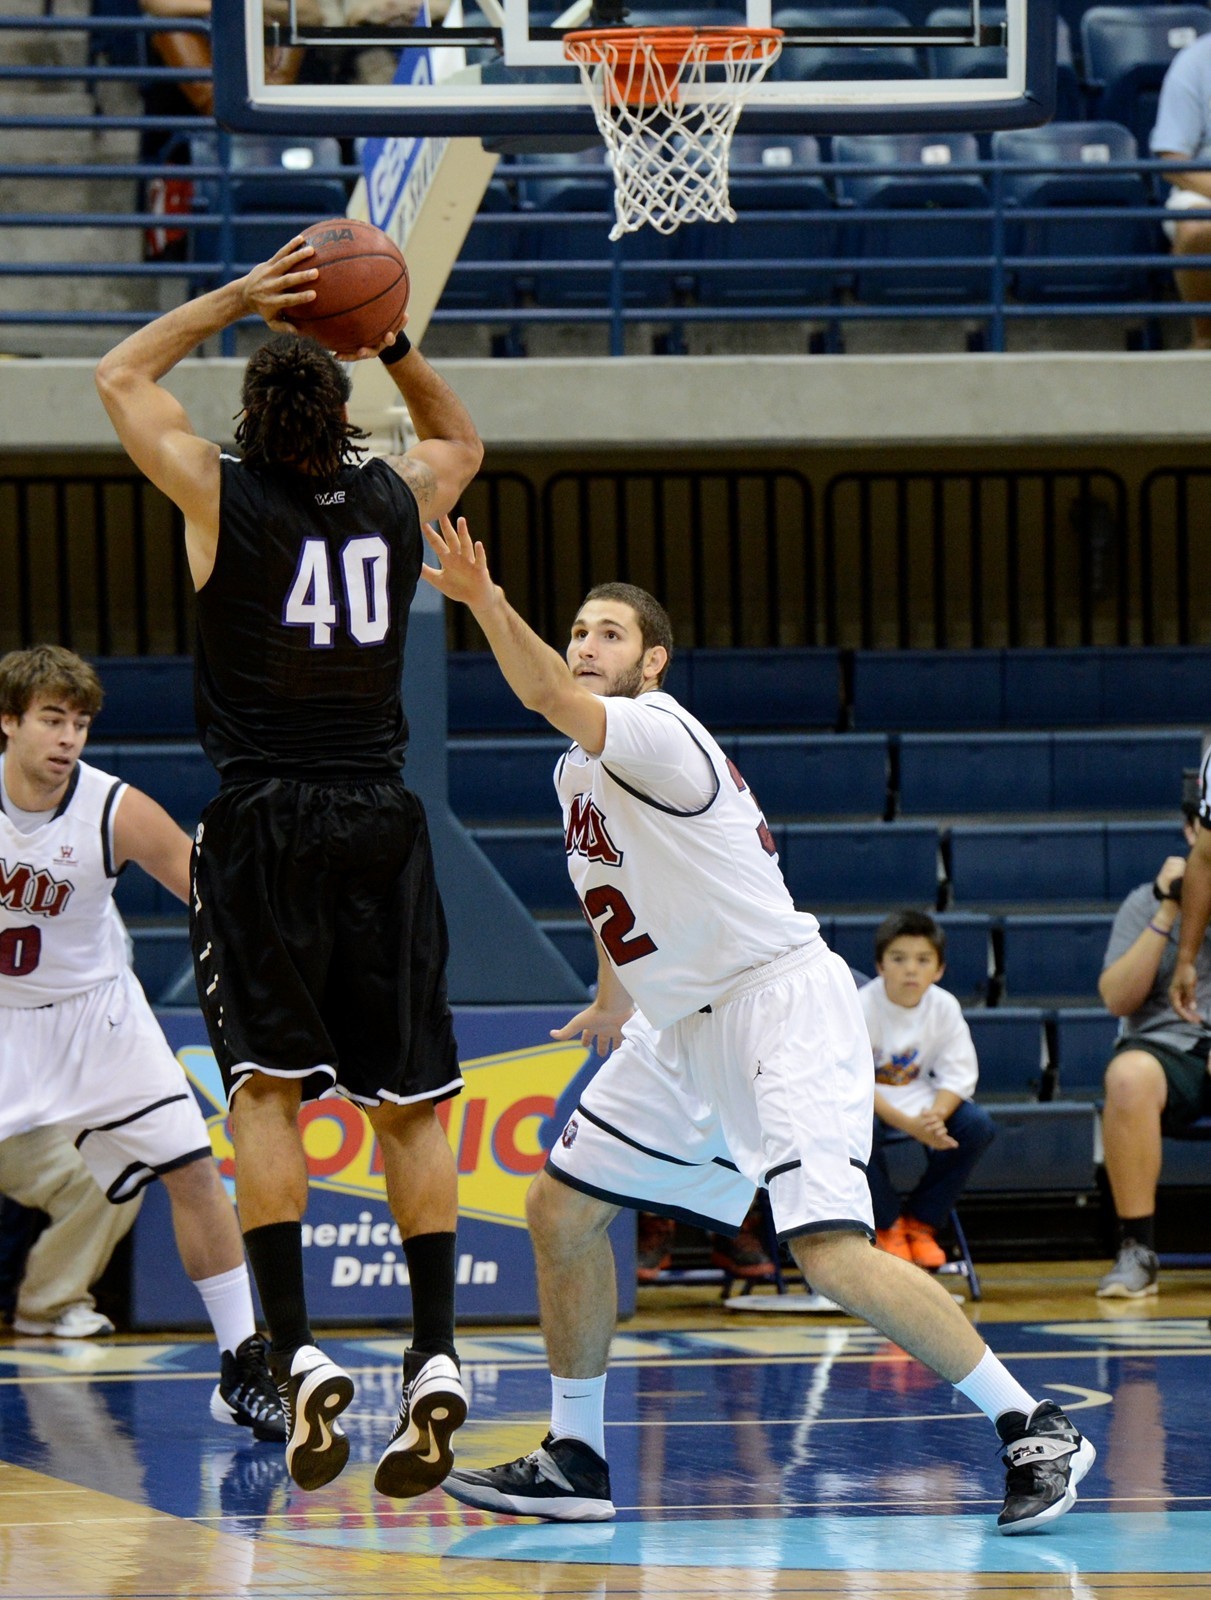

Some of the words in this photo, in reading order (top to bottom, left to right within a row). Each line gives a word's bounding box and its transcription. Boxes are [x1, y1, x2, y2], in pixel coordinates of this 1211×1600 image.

[314, 490, 346, 506] WAC
[278, 532, 392, 649] 40
[576, 883, 659, 967] 2
[219, 1095, 556, 1180] OIC
